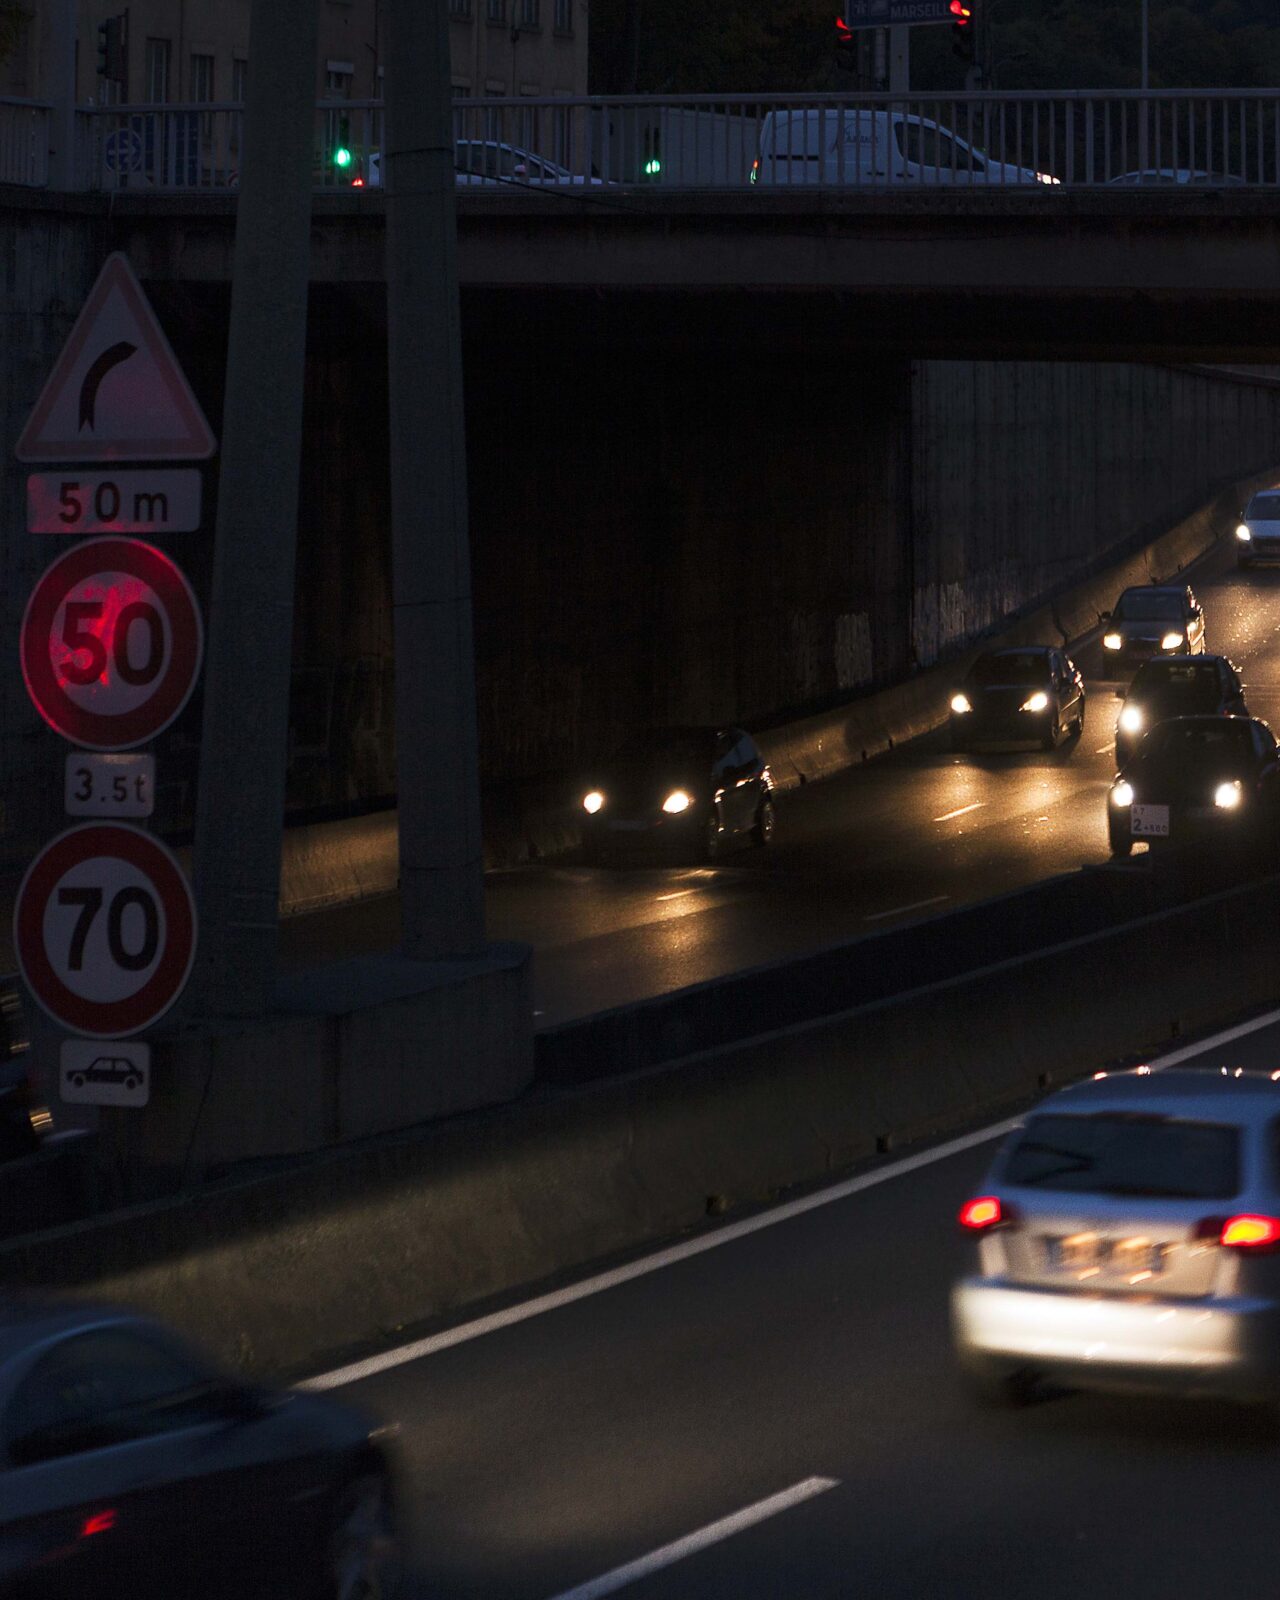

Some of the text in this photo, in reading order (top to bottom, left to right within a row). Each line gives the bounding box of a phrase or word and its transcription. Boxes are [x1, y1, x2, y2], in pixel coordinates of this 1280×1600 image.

[890, 3, 957, 18] MARSEILL
[59, 601, 165, 686] 50
[74, 767, 148, 803] 3.5t
[57, 886, 159, 971] 70
